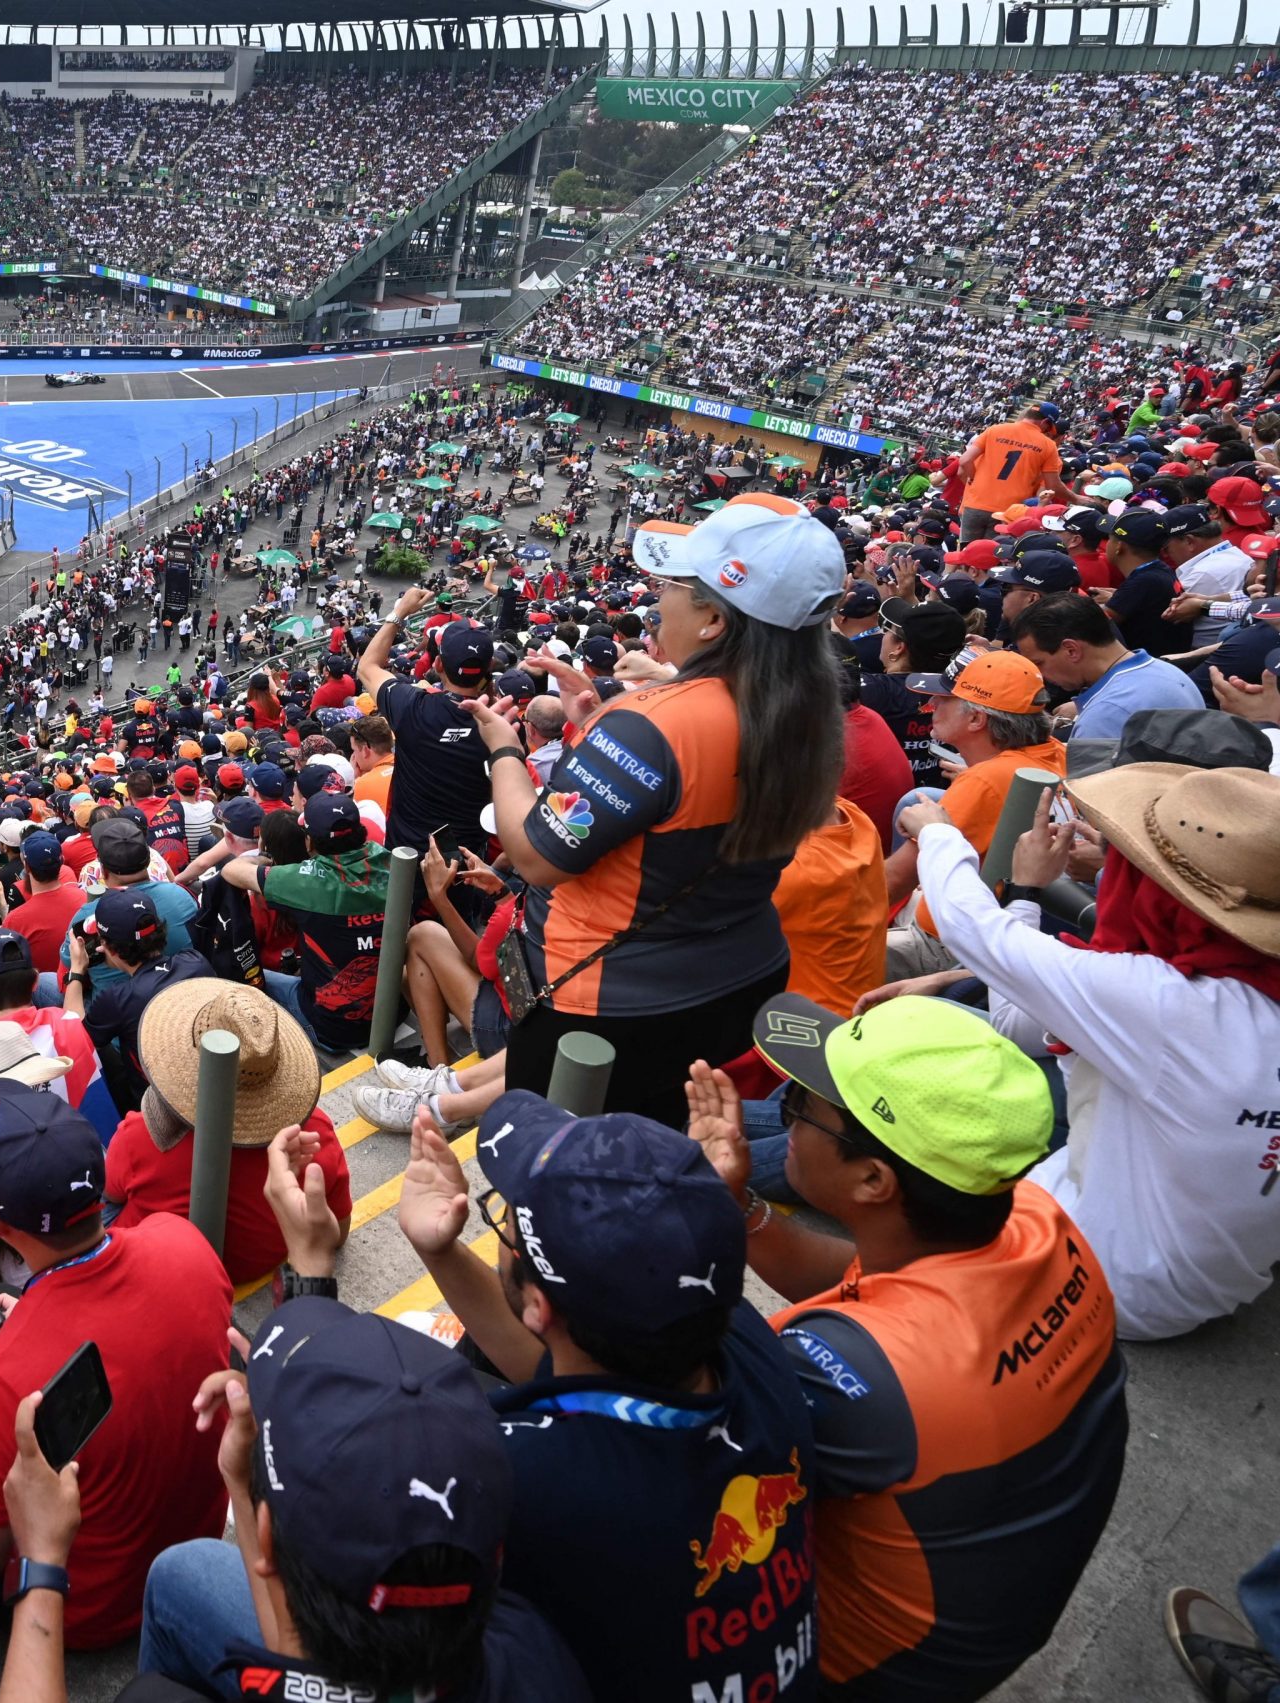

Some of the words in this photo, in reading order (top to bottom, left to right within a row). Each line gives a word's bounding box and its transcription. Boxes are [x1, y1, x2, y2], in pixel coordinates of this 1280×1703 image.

[627, 86, 705, 107] MEXICO
[711, 89, 761, 109] CITY
[680, 109, 709, 119] CDMX
[203, 348, 262, 359] #MexicoGP
[997, 450, 1023, 481] 1
[723, 563, 745, 585] Gulf
[960, 681, 993, 699] CarNext
[572, 763, 632, 815] smartsheet
[540, 803, 582, 849] CNBC
[516, 1206, 567, 1284] telcel
[991, 1264, 1091, 1386] McLaren
[263, 1418, 285, 1491] telcel
[685, 1566, 772, 1659] Red
[239, 1667, 282, 1695] F1
